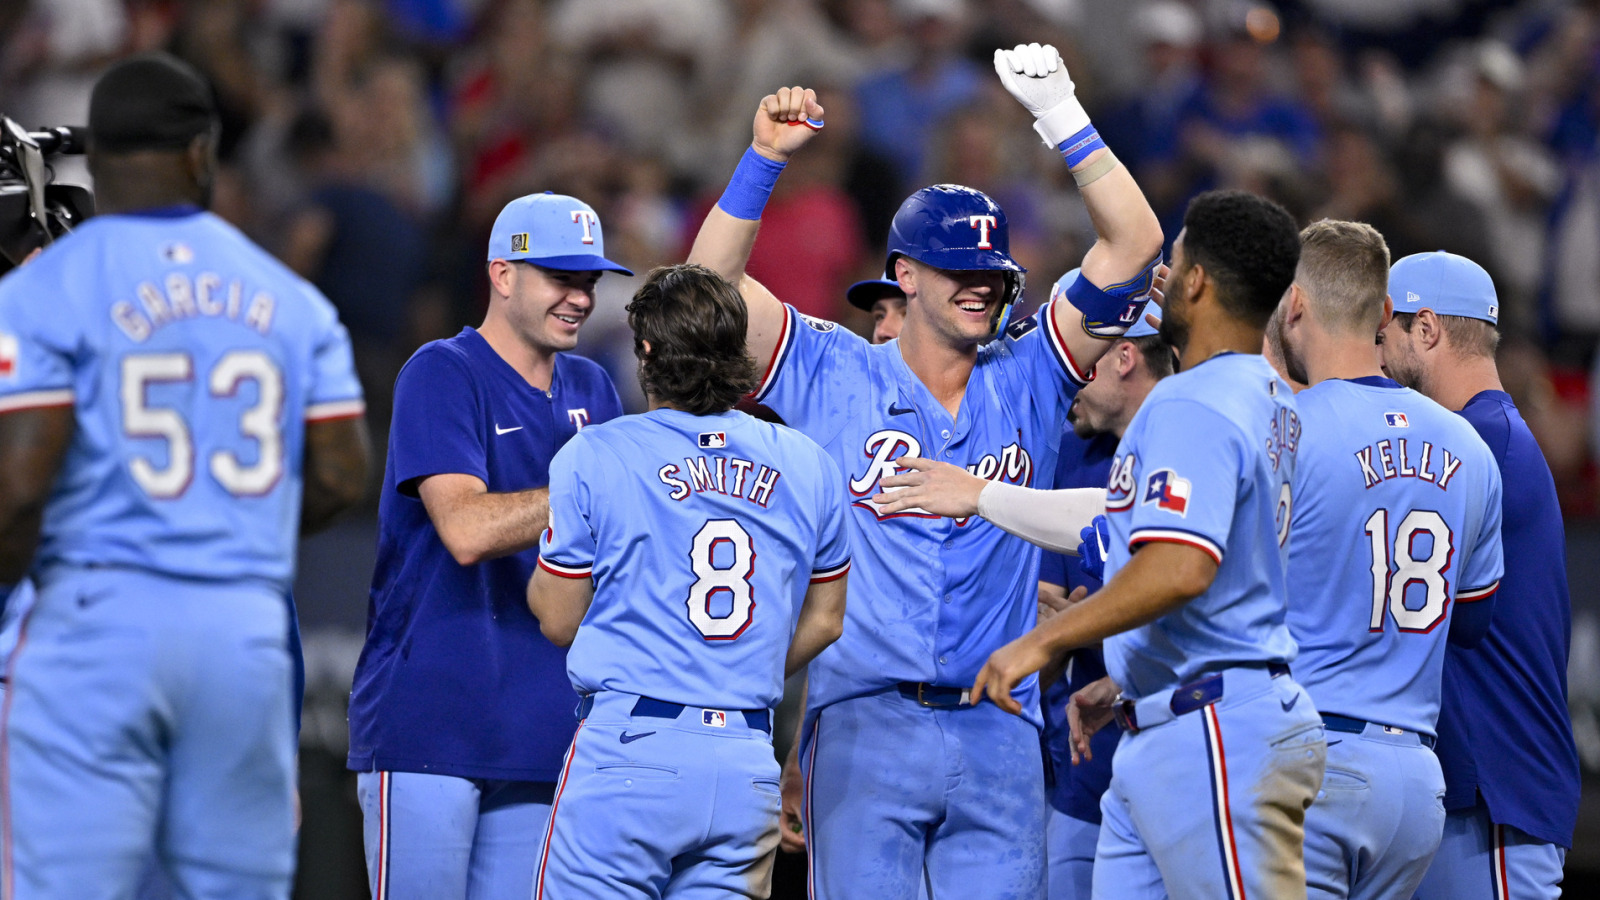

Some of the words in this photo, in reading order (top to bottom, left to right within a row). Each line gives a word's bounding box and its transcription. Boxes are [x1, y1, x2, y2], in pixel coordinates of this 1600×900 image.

[511, 232, 529, 253] 61
[570, 210, 596, 245] T
[970, 215, 997, 250] T
[110, 271, 276, 343] GARCIA
[120, 352, 285, 500] 53
[567, 408, 590, 432] T
[658, 456, 781, 508] SMITH
[1354, 438, 1461, 491] KELLY
[685, 518, 757, 641] 8
[1365, 508, 1455, 634] 18
